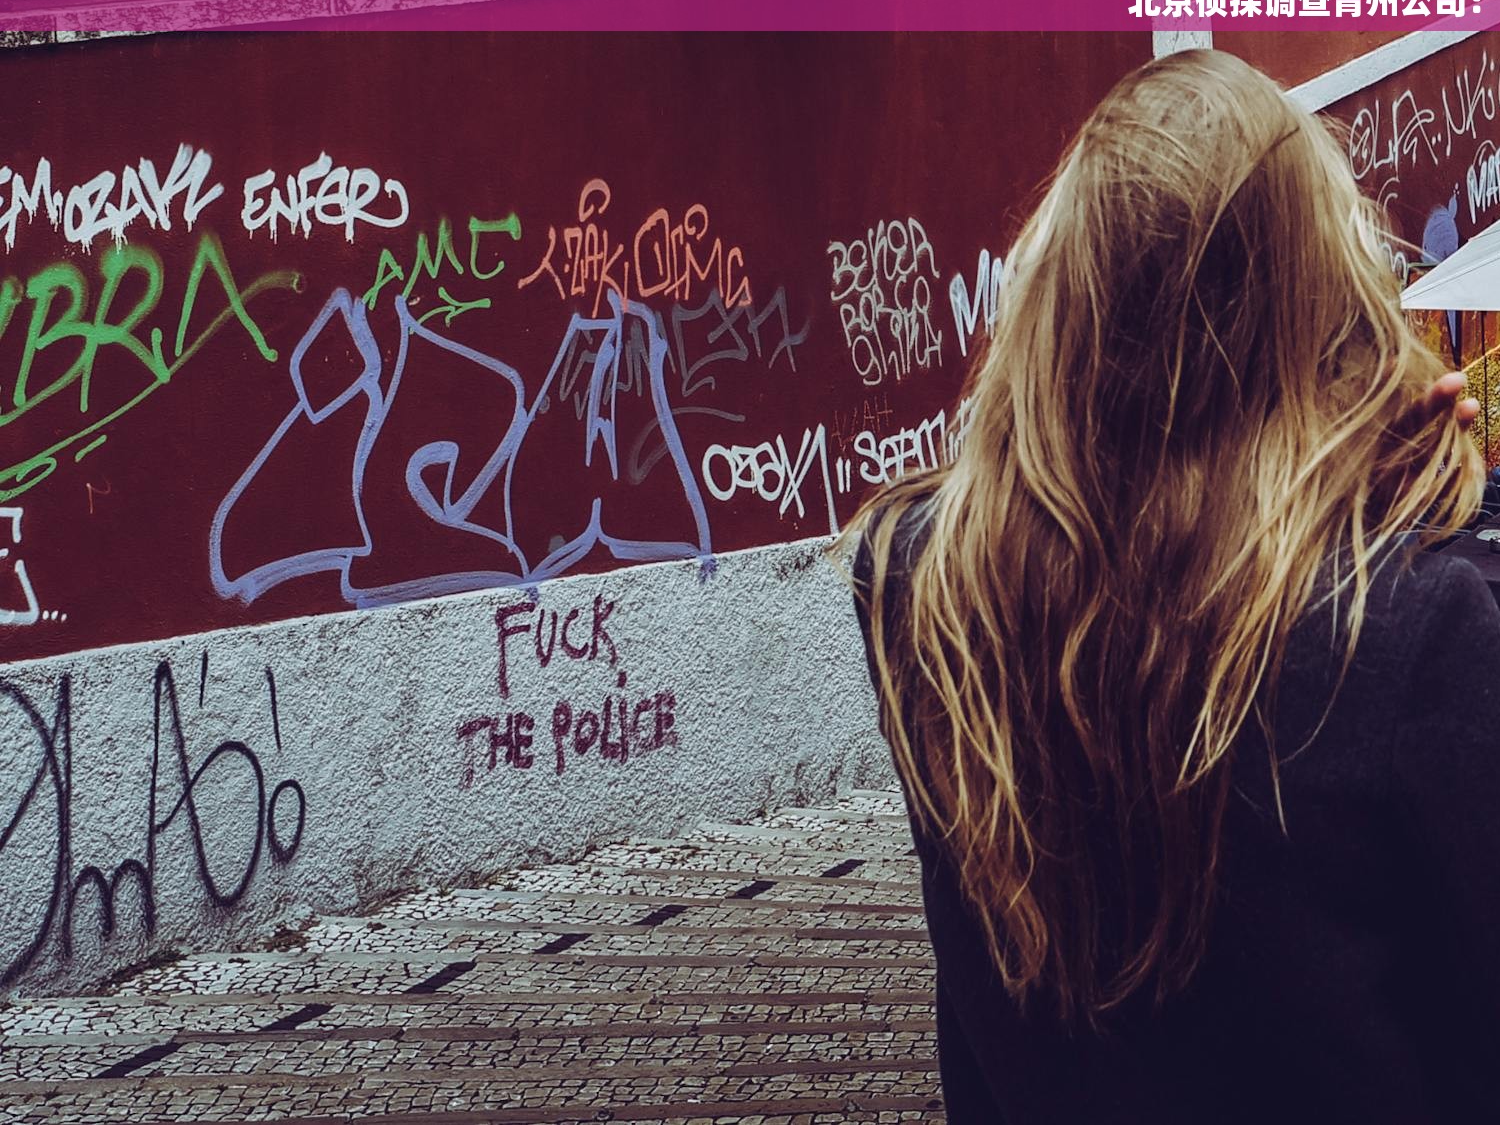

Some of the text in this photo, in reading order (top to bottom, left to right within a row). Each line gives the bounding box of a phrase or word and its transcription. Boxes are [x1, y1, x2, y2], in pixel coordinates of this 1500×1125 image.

[495, 594, 618, 699] FUCK
[456, 673, 678, 789] THE POLICE
